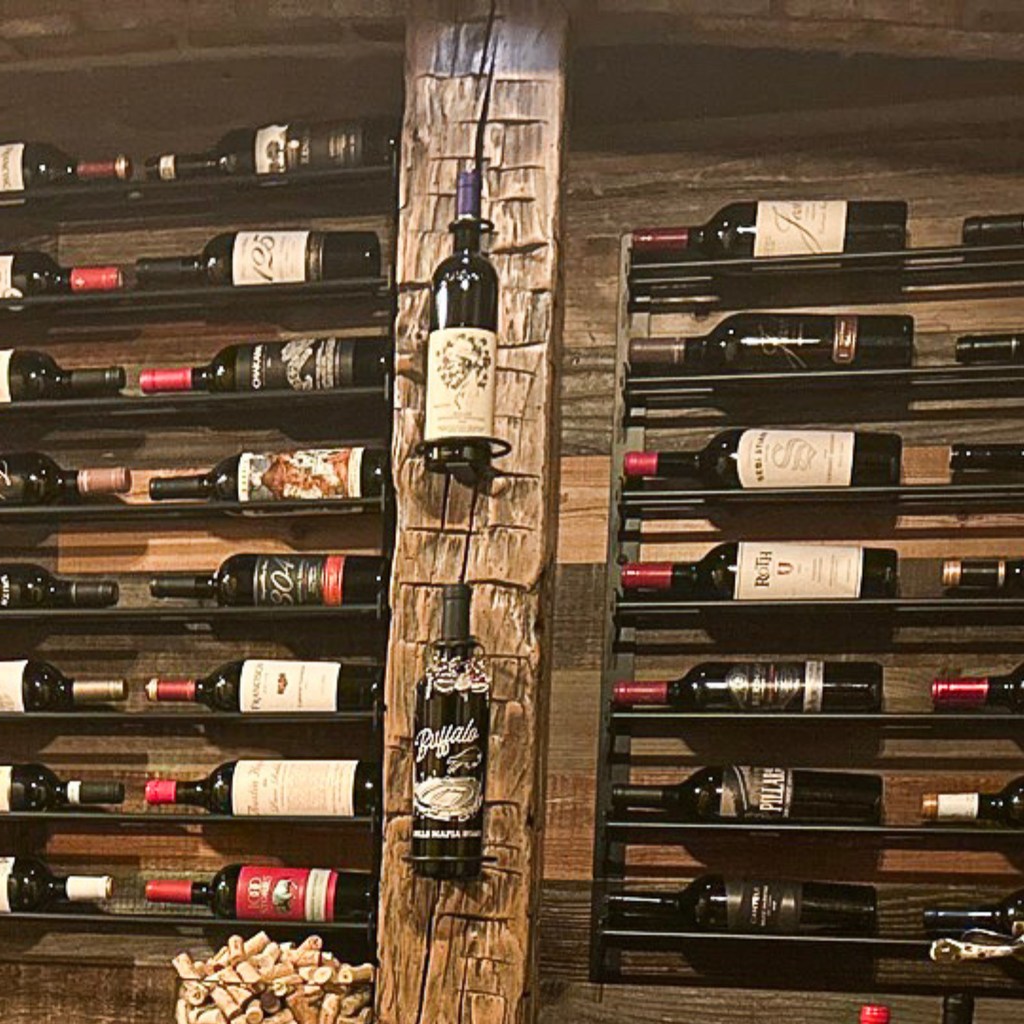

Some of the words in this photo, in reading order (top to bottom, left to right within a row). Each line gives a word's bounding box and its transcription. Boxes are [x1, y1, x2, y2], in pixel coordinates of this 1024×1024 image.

[251, 234, 275, 282] 125
[755, 432, 768, 482] SEBASTIAN
[754, 551, 773, 587] ROTH
[414, 718, 480, 763] Buffalo
